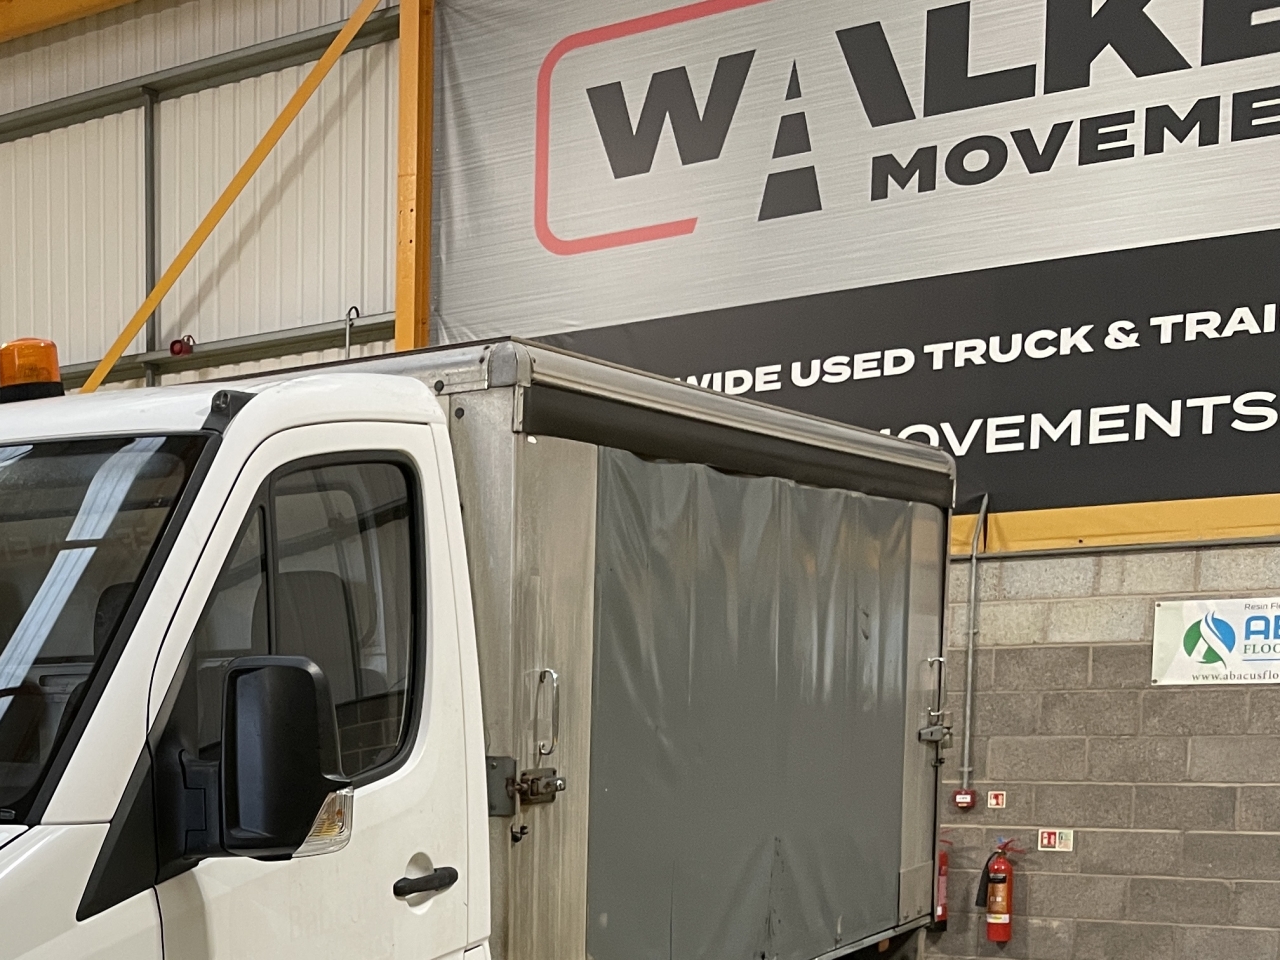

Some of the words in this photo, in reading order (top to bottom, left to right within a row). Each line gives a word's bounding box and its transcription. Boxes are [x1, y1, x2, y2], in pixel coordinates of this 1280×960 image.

[870, 85, 1280, 201] MOVEME
[791, 348, 915, 387] USED
[923, 325, 1095, 369] TRUCK
[1104, 320, 1140, 350] &
[1150, 303, 1276, 344] TRAI
[880, 391, 1279, 457] OVEMENTS
